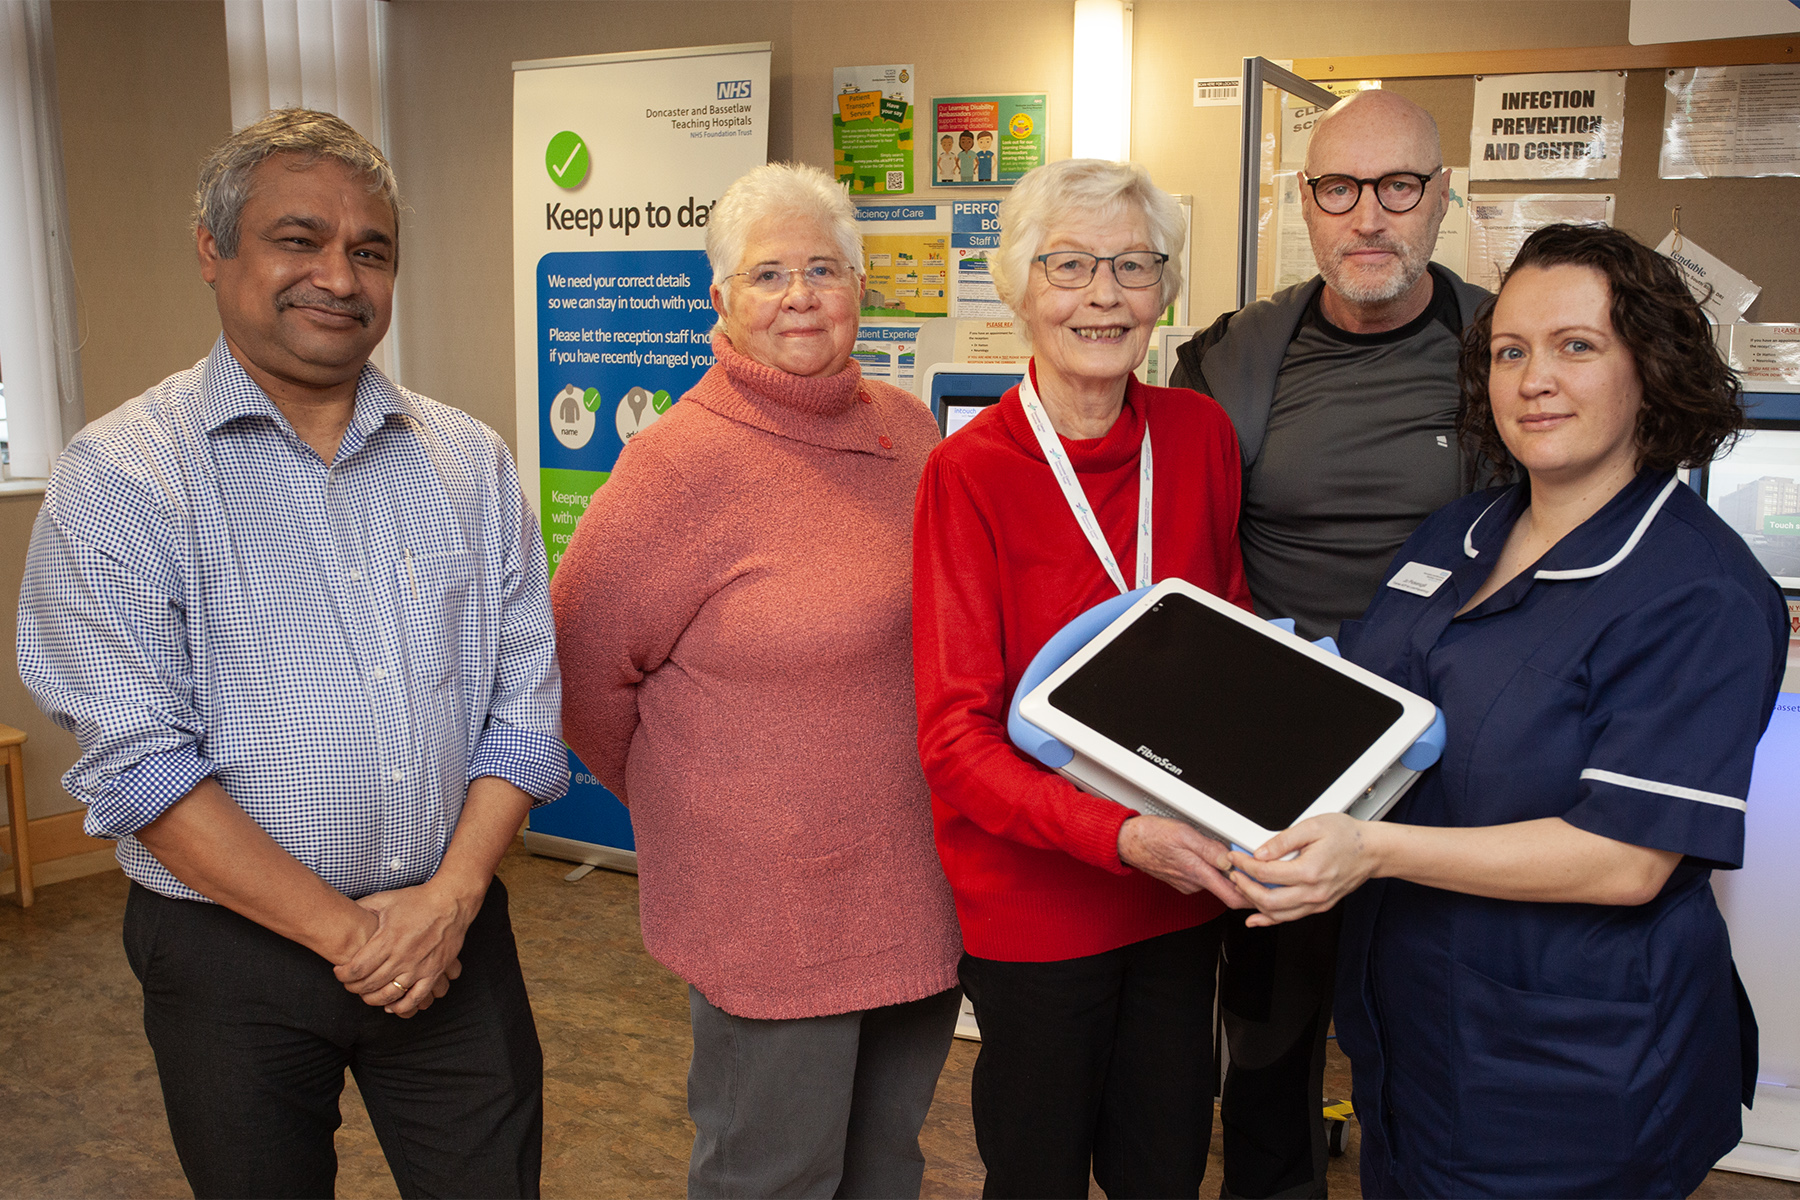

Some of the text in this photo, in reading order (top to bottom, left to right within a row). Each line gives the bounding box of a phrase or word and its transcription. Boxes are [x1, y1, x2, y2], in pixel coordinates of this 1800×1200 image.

[717, 80, 751, 100] NHS
[846, 102, 874, 110] Transport
[1502, 90, 1596, 110] INFECTION
[646, 103, 752, 118] Doncaster and Bassetlaw
[671, 116, 752, 130] Teaching Hospitals
[1492, 116, 1602, 135] PREVENTION
[704, 130, 736, 138] Foundation
[1483, 142, 1606, 160] AND CONTR
[546, 196, 716, 236] Keep up to da
[891, 209, 900, 218] of
[902, 208, 924, 218] Care
[955, 203, 998, 214] PERFO
[982, 219, 1002, 230] BO
[970, 236, 991, 246] Staff
[1670, 250, 1706, 277] tendable
[548, 274, 690, 290] We need your correct details
[548, 296, 712, 312] so we can stay in touch with you.
[549, 328, 711, 346] Please let the reception staff kno
[549, 349, 717, 368] if you have recently changed your
[552, 490, 588, 508] Keeping
[552, 511, 573, 524] with
[552, 532, 574, 544] rece
[1774, 704, 1800, 712] asset
[1136, 745, 1183, 775] FibroScan
